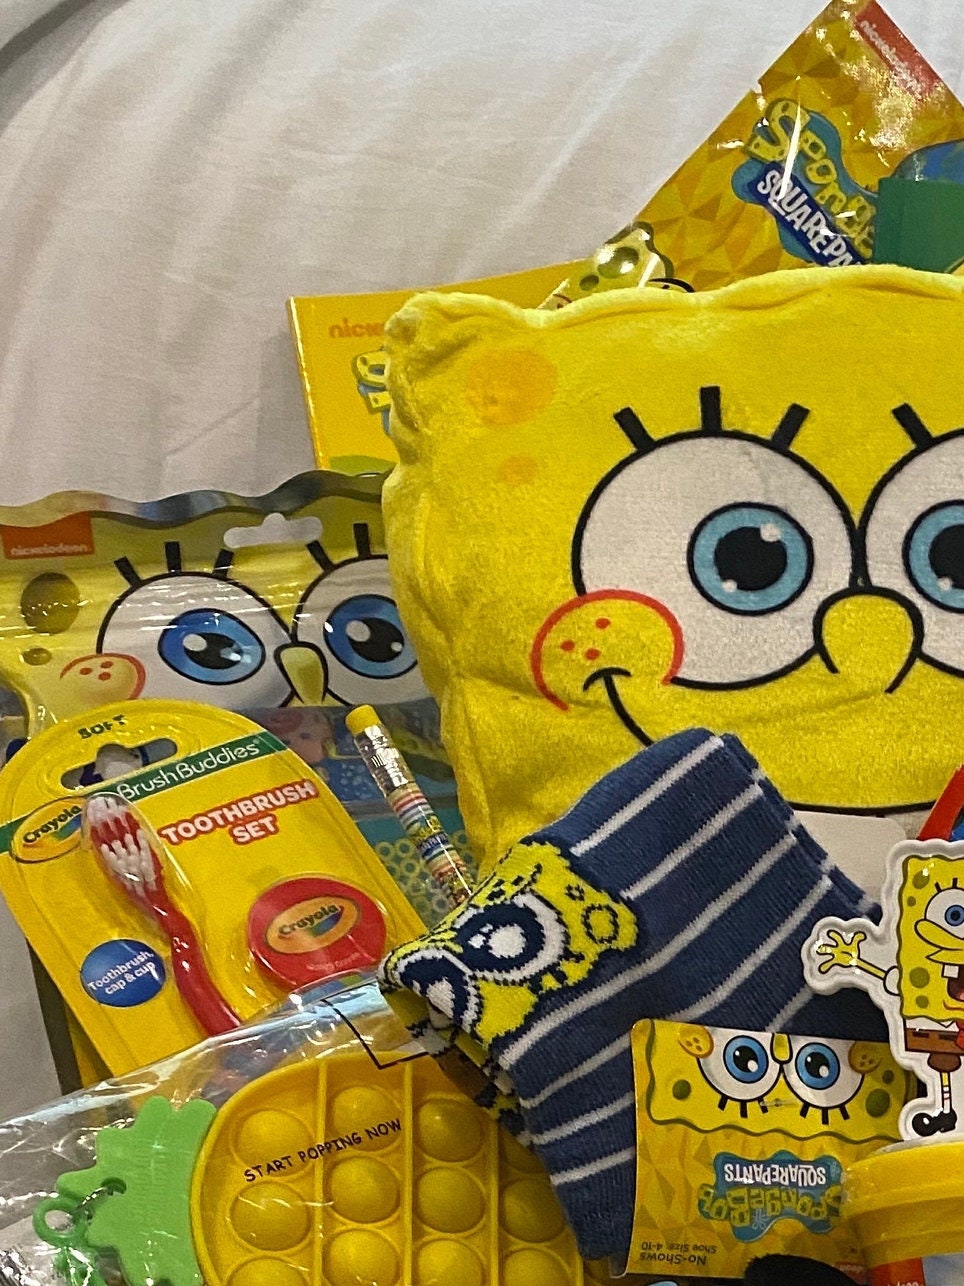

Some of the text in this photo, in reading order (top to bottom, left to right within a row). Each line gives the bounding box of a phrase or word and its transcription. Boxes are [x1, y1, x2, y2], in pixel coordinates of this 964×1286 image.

[757, 169, 868, 267] SQUAREPA
[22, 803, 84, 847] Crayola
[161, 780, 317, 845] TOOTHBRUSH
[232, 815, 276, 844] SET
[277, 903, 341, 937] Crayola
[104, 960, 157, 996] cap & cup
[243, 1118, 402, 1182] START POPPING NOW
[723, 1162, 827, 1187] SQUAREPANTS
[698, 1183, 843, 1228] SpongeBob
[639, 1253, 707, 1266] No-Shows
[641, 1240, 664, 1251] 4-10
[692, 1244, 718, 1255] Shoe
